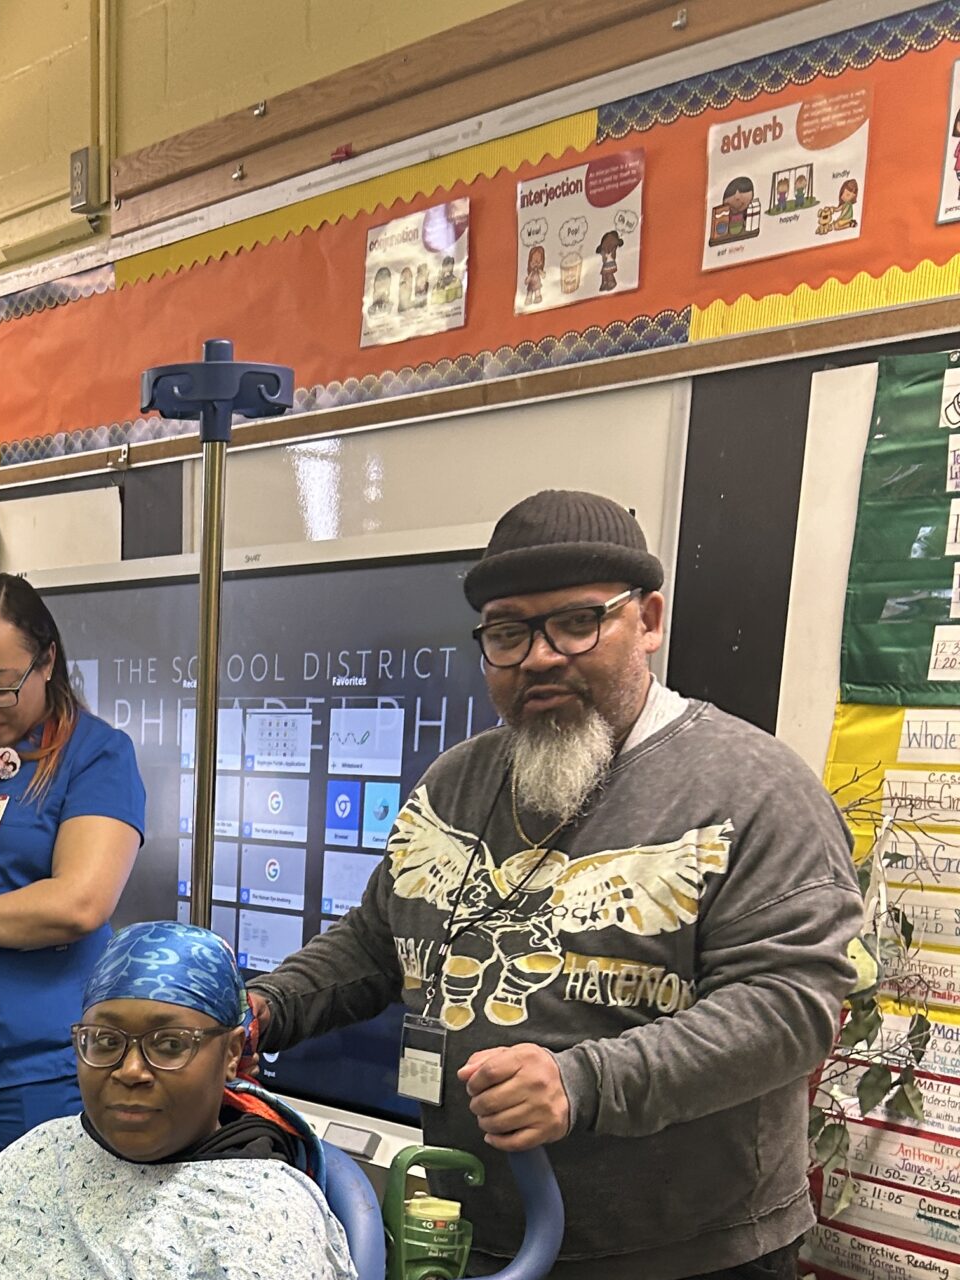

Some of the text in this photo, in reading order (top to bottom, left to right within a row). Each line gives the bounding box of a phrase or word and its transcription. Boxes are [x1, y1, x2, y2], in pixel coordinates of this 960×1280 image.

[721, 115, 783, 154] adverb
[831, 169, 851, 180] kindly
[520, 177, 583, 209] interjection
[779, 214, 800, 225] happily
[113, 647, 457, 685] THE SCOOL DISTRICT
[332, 676, 367, 687] Favorites
[114, 695, 504, 754] PHIEPHI
[906, 720, 957, 749] Whole
[886, 780, 938, 810] Whole
[886, 841, 930, 872] hole
[914, 1077, 952, 1095] MATH
[872, 1187, 905, 1205] 11:05
[850, 1238, 901, 1263] Corrective
[905, 1254, 950, 1280] Reading
